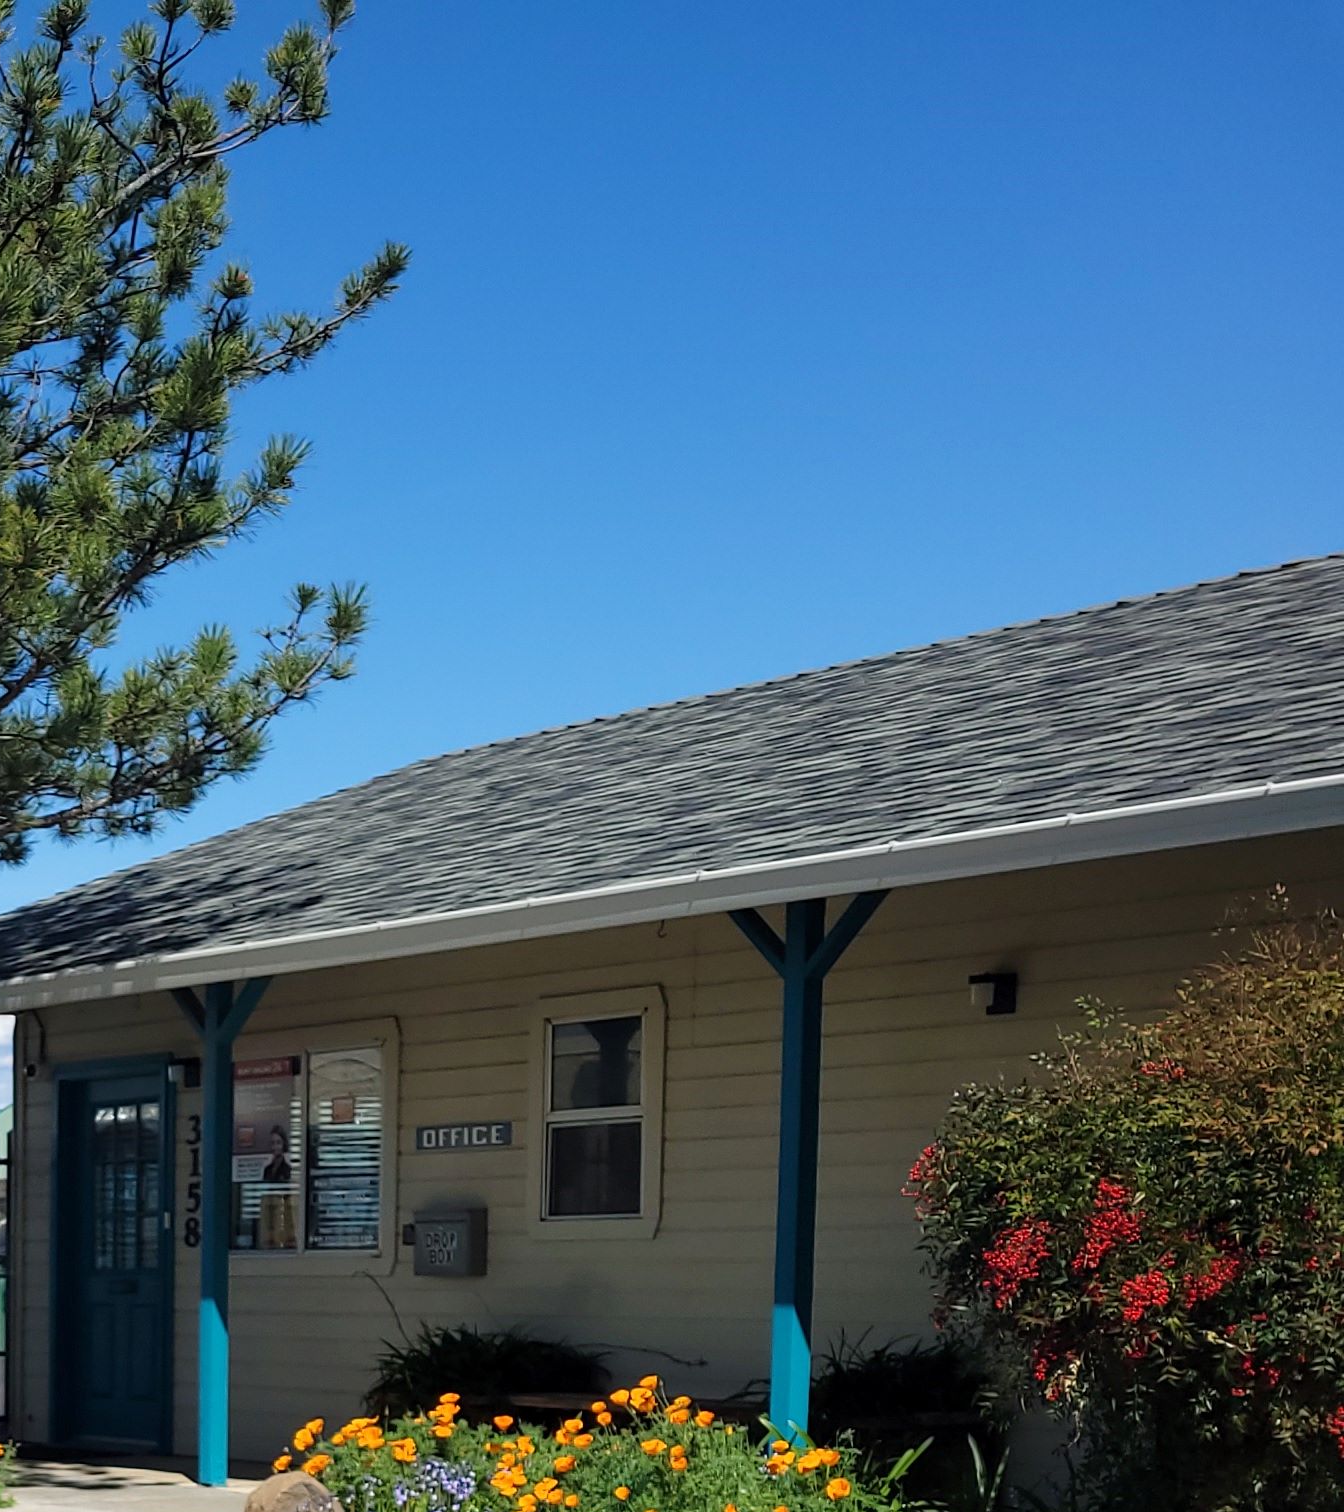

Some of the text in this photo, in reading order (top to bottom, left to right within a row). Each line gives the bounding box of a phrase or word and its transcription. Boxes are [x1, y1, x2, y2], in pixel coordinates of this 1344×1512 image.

[422, 1125, 505, 1148] OFFICE
[184, 1115, 201, 1247] 3158
[425, 1232, 457, 1248] DROP
[429, 1249, 454, 1264] BOX
